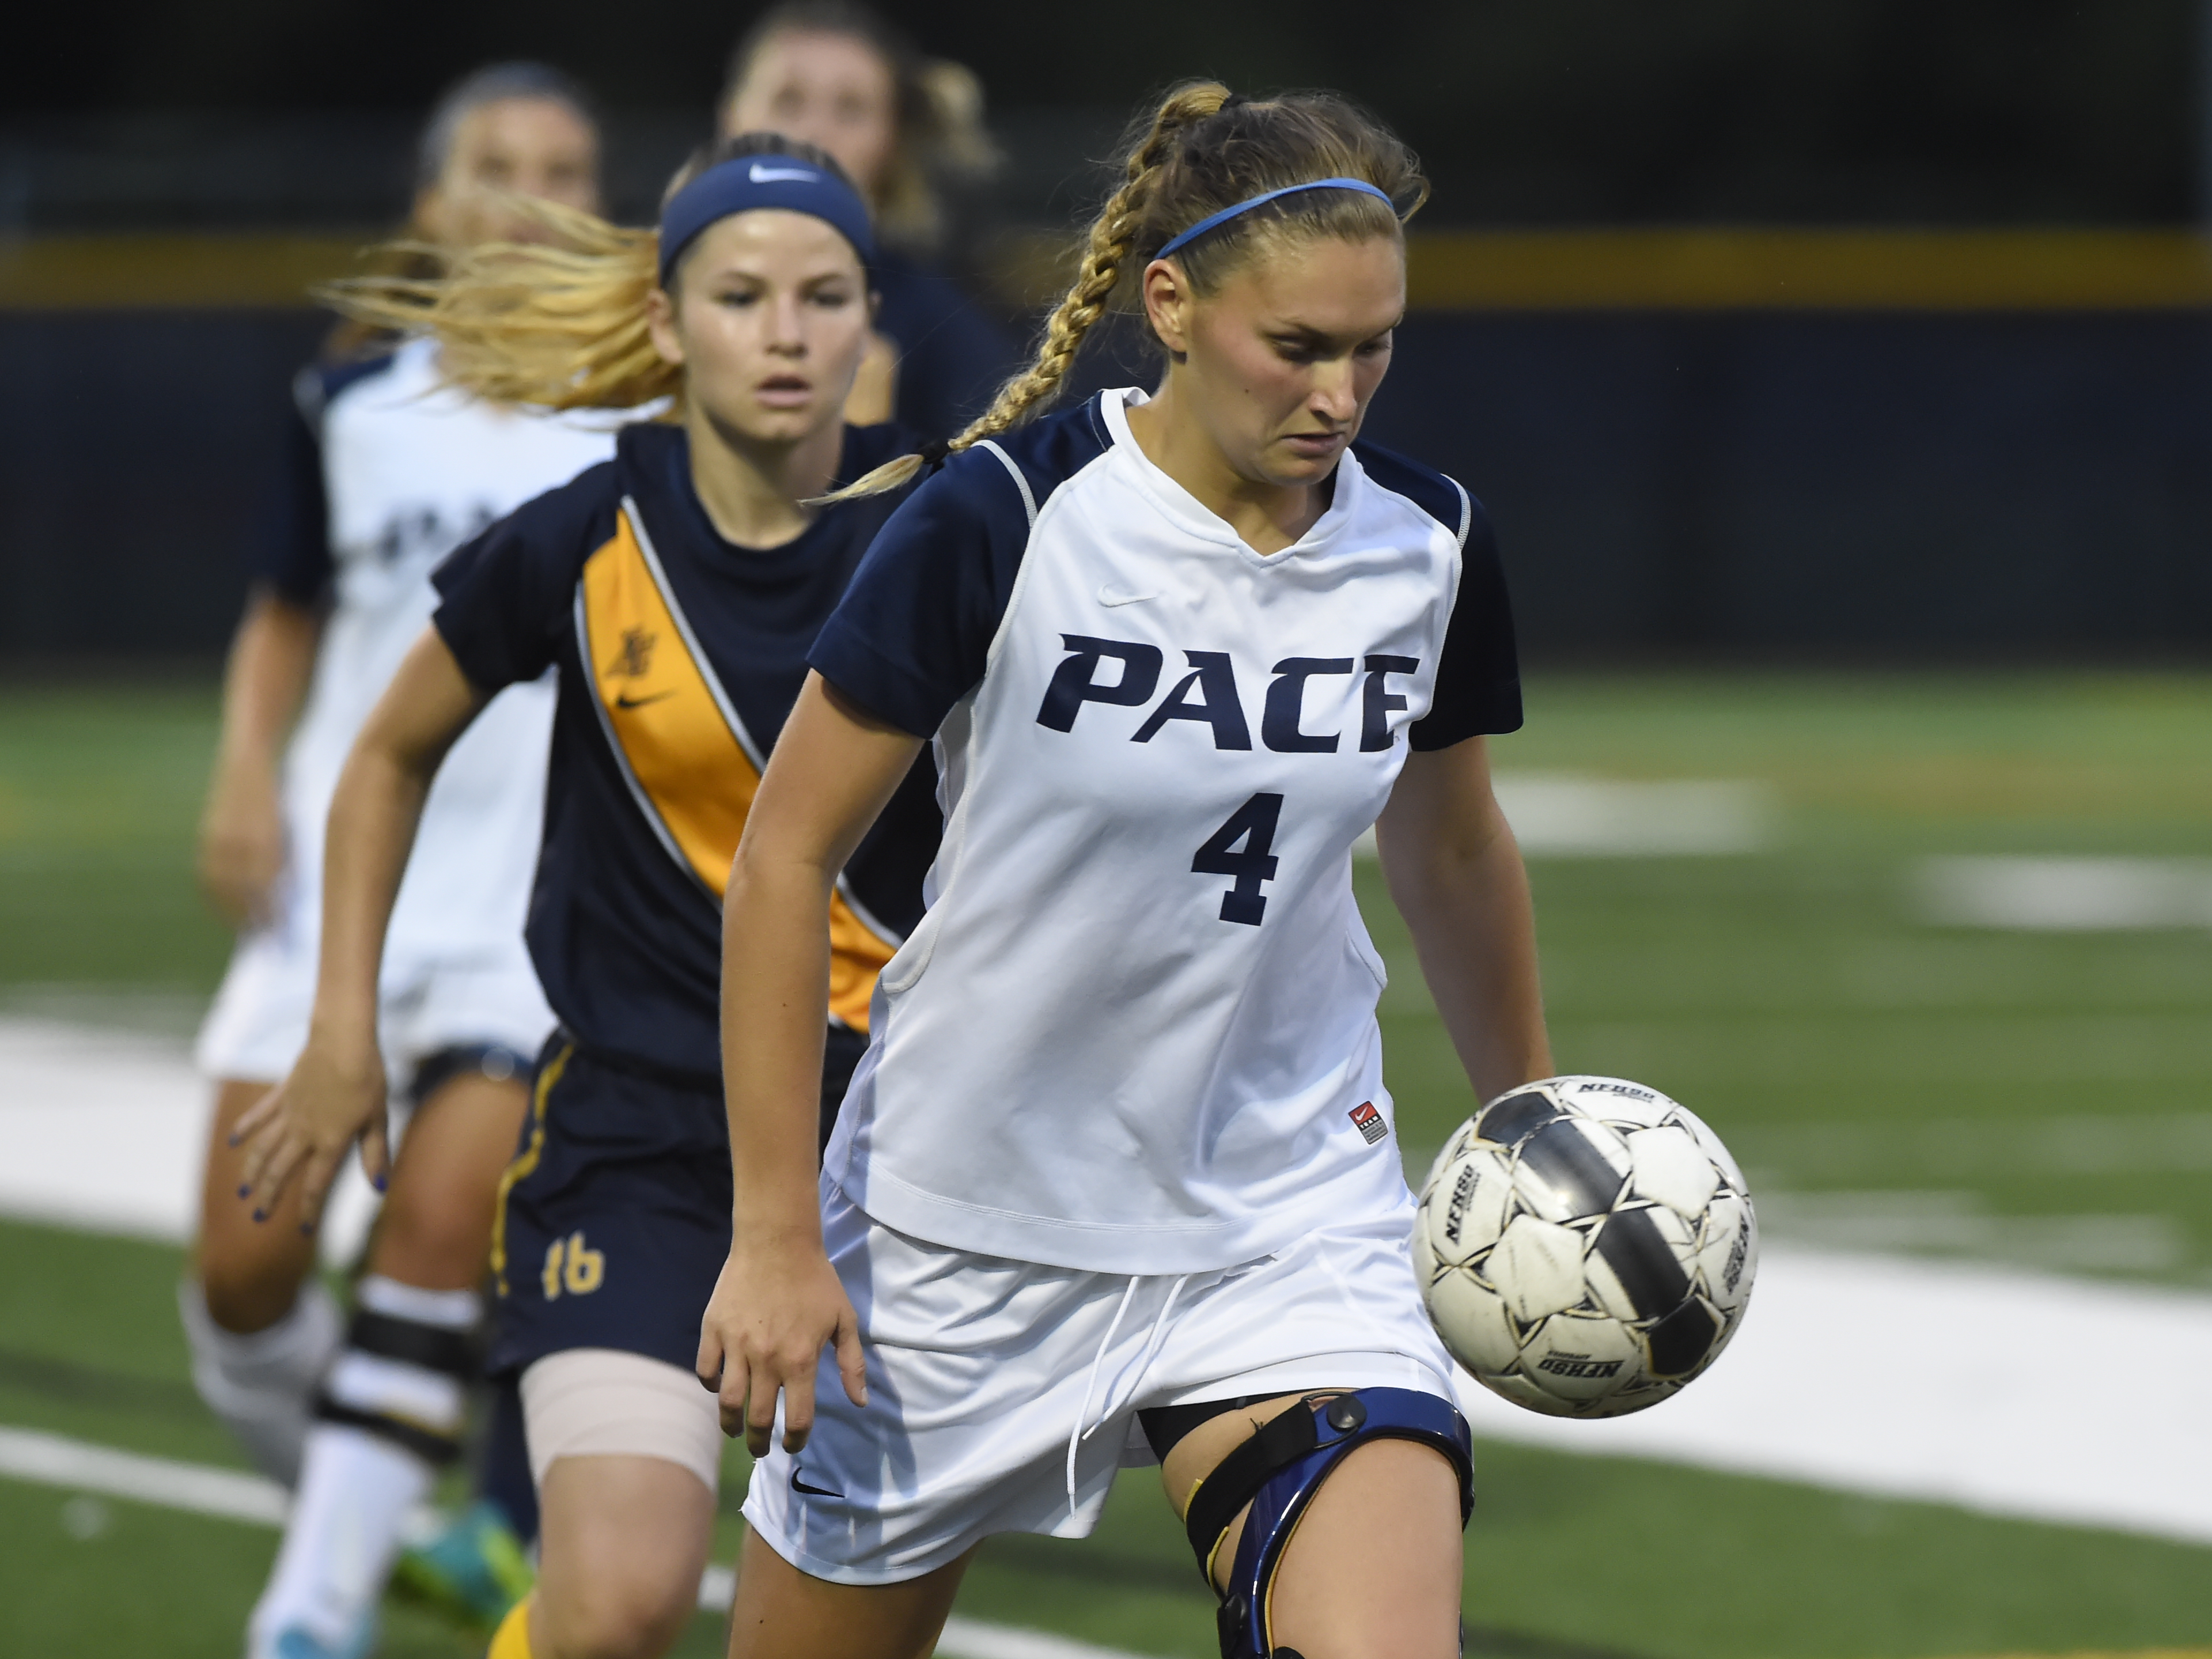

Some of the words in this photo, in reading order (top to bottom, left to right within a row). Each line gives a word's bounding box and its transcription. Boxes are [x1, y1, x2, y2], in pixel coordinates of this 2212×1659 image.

[1036, 633, 1421, 753] PACE
[1190, 792, 1284, 926] 4
[540, 1229, 606, 1302] 16
